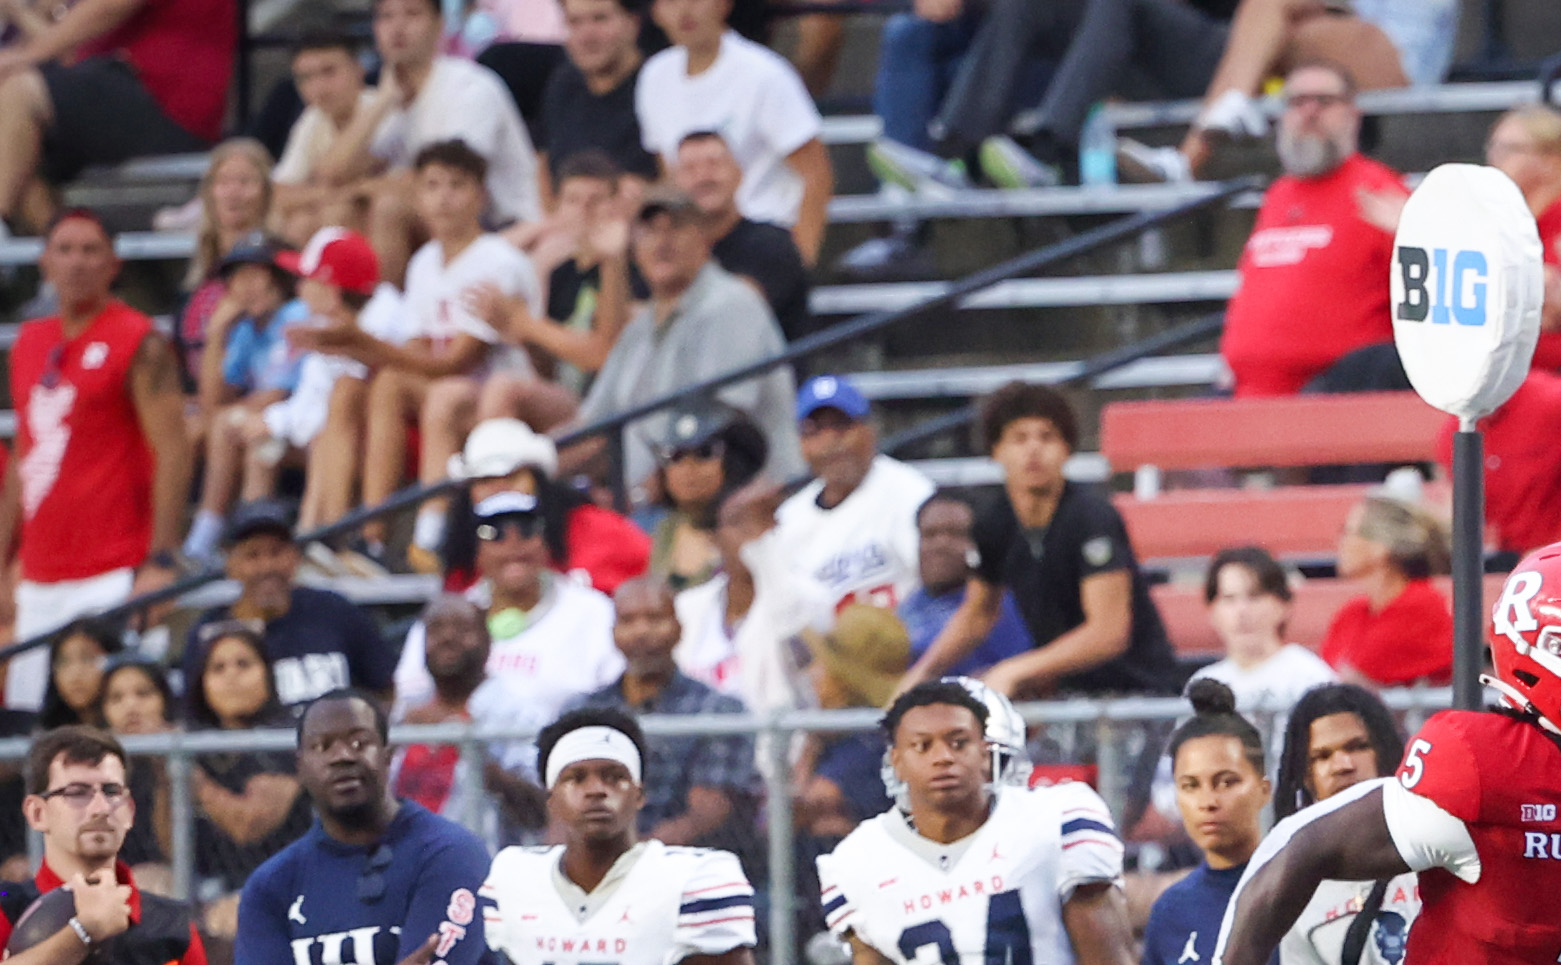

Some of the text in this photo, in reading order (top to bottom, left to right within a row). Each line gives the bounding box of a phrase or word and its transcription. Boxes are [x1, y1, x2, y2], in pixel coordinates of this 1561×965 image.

[1493, 570, 1543, 635] R
[1401, 738, 1432, 789] 5
[903, 875, 1004, 914] HOWARD
[536, 937, 628, 954] HOWARD
